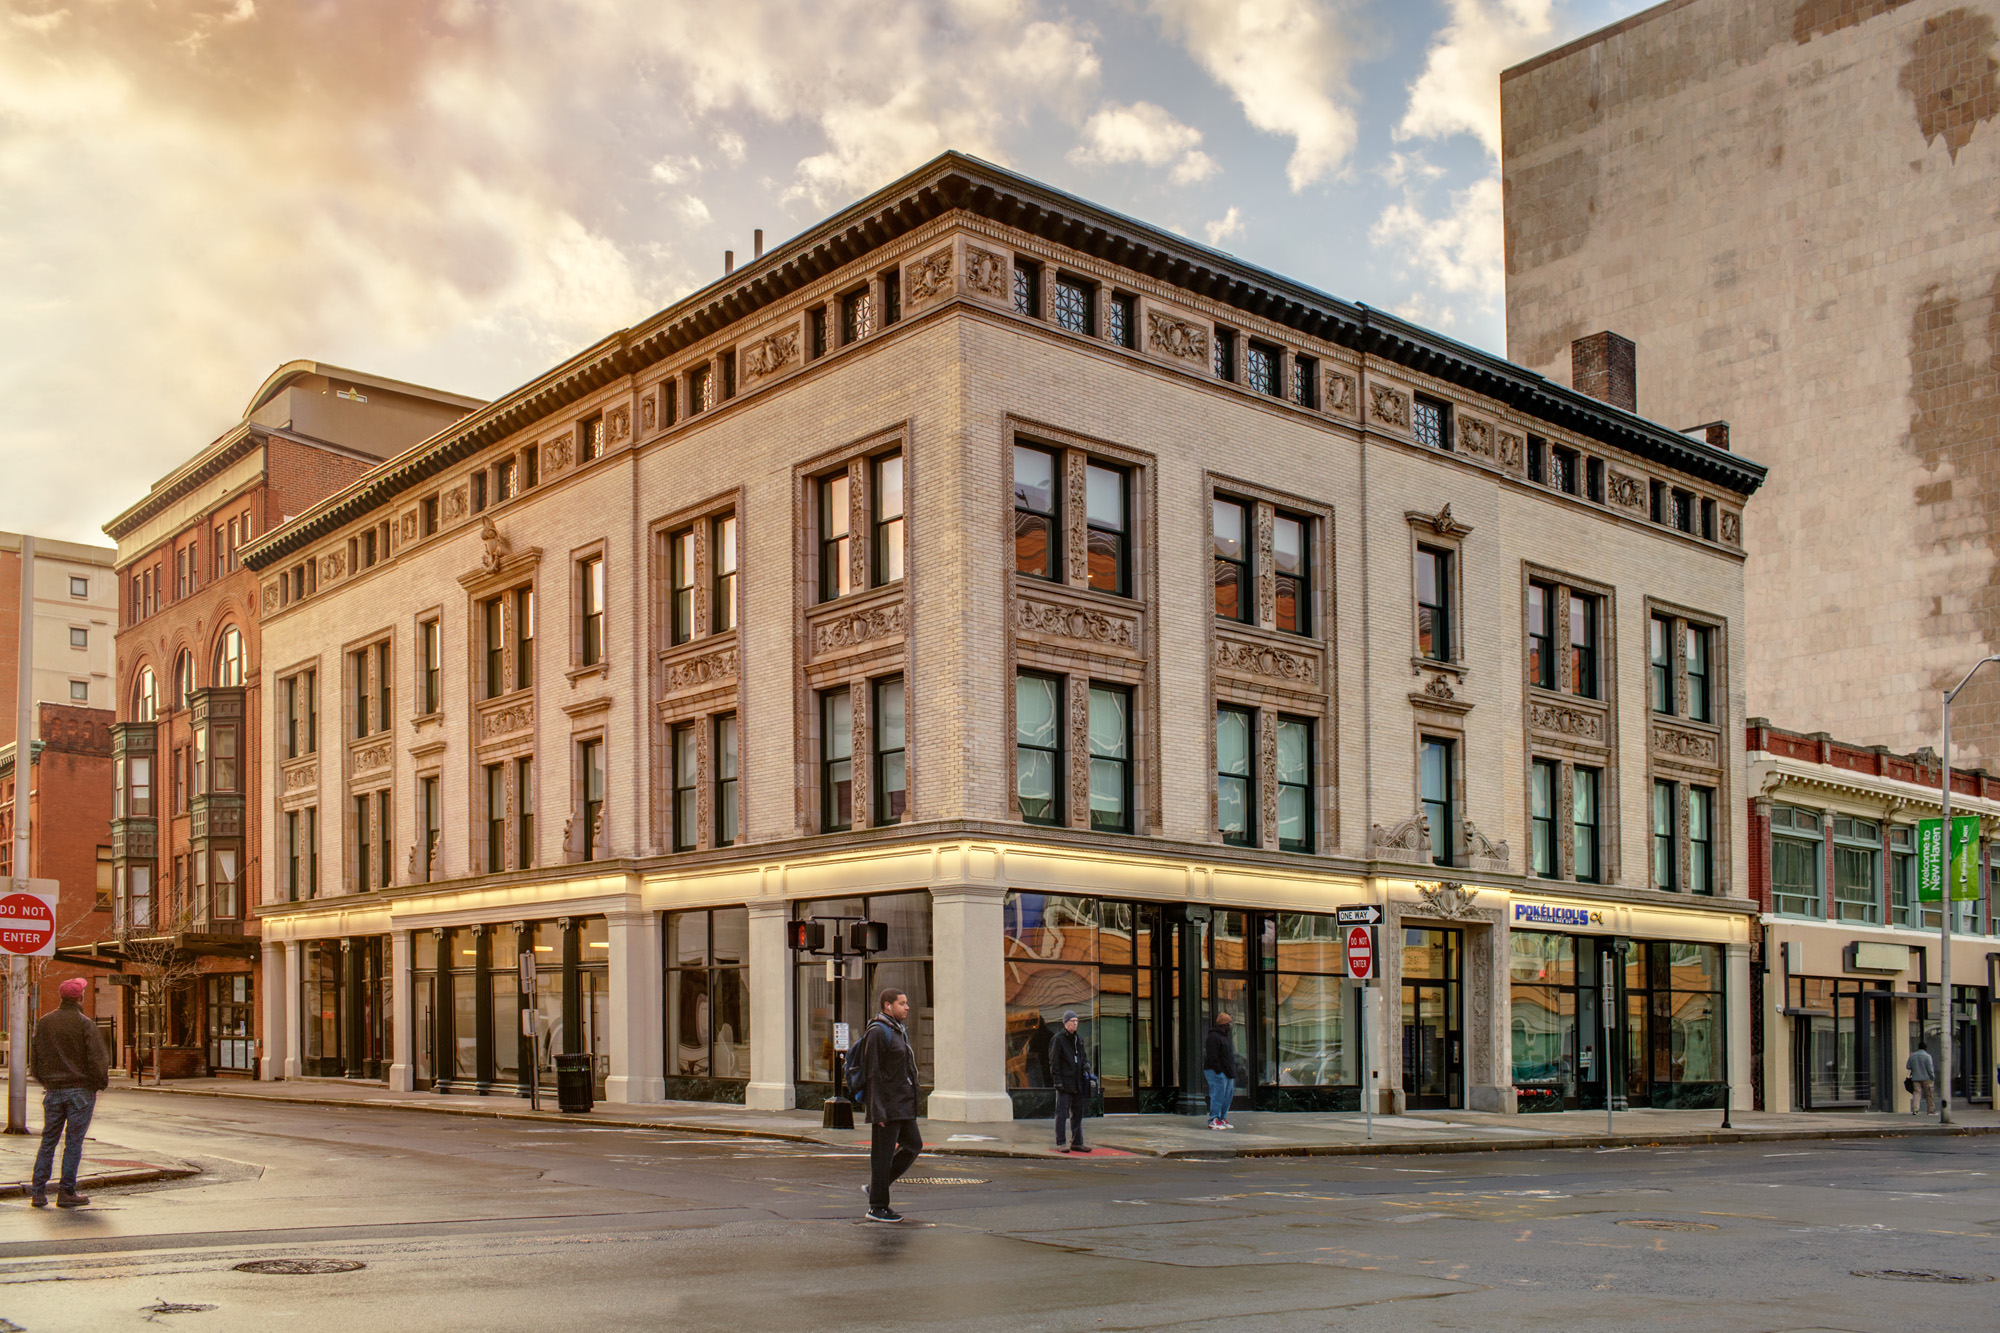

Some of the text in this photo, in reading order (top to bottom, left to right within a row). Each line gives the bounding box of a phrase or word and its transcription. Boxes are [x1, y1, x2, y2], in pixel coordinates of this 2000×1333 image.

[1921, 830, 1931, 889] Welcome to
[1930, 826, 1941, 891] New Haven
[0, 904, 45, 917] DO NOT
[1340, 911, 1368, 920] ONE WAY
[3, 932, 40, 943] ENTER
[1350, 937, 1367, 946] DO NOT
[1353, 960, 1367, 968] ENTER
